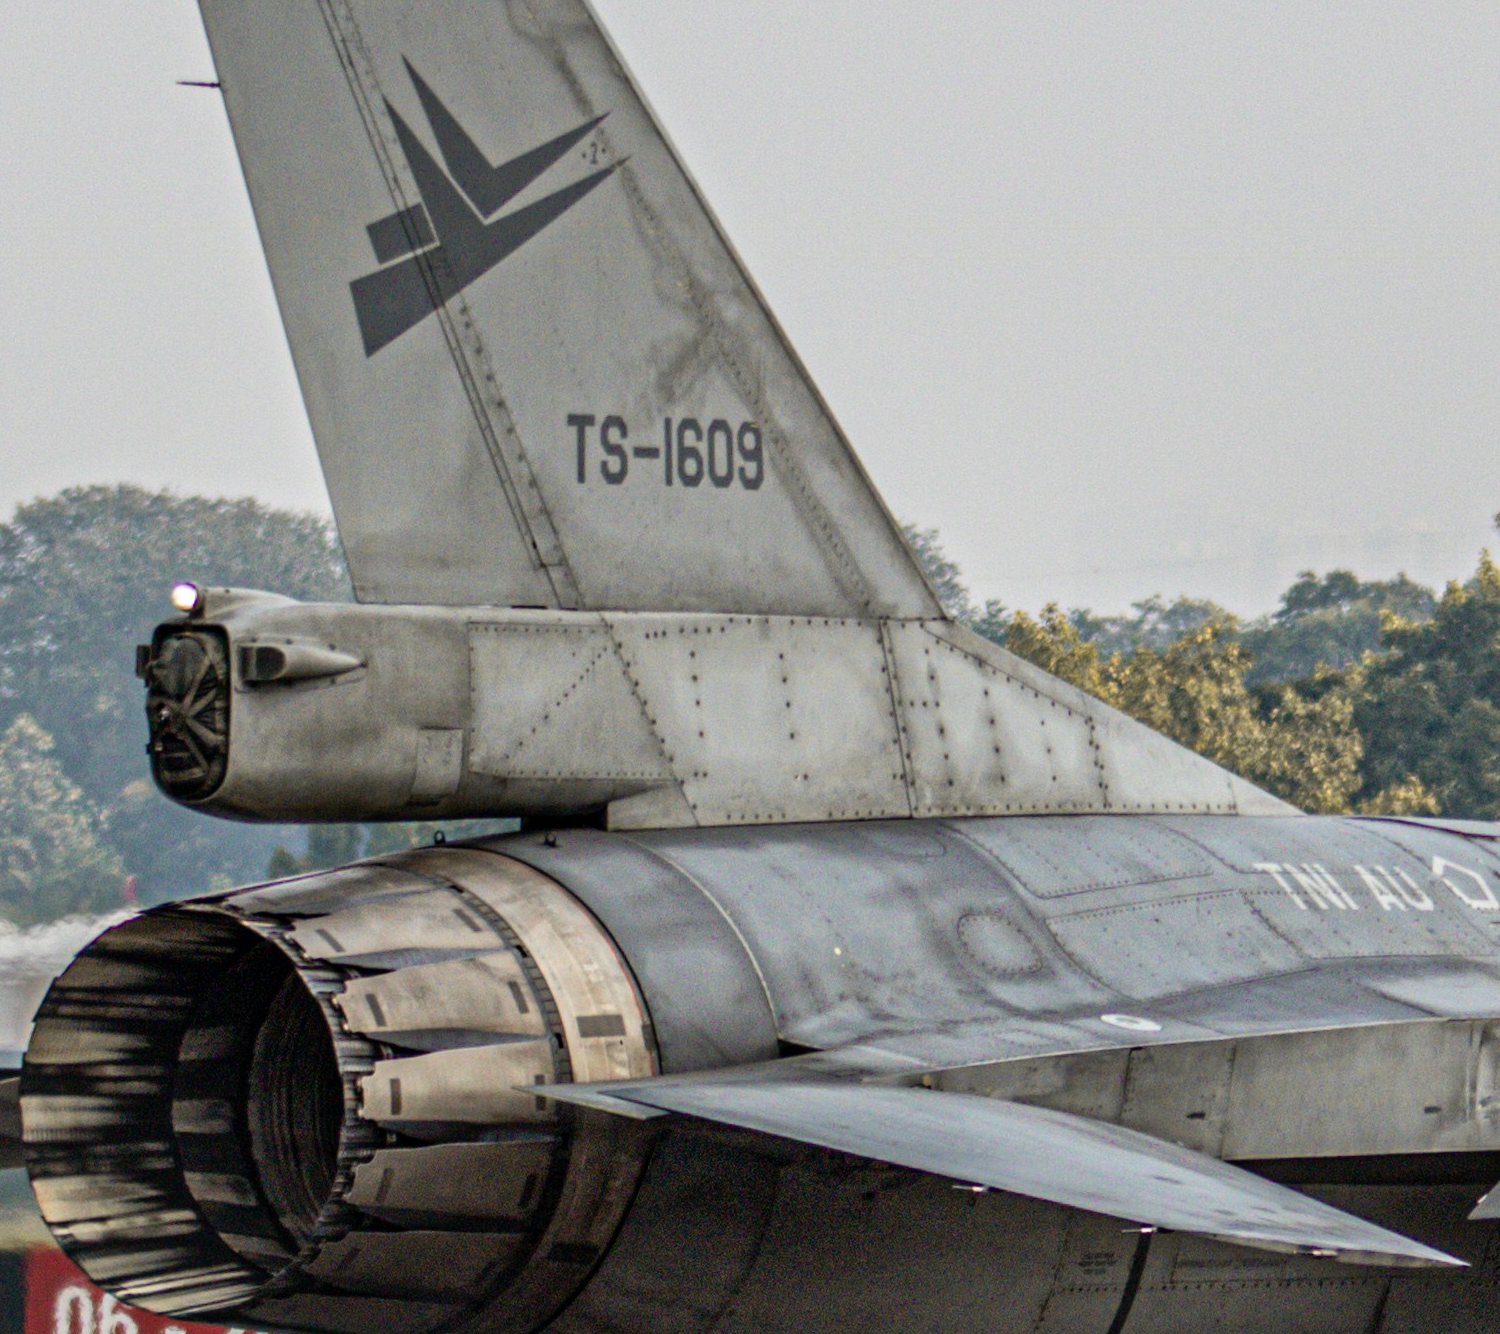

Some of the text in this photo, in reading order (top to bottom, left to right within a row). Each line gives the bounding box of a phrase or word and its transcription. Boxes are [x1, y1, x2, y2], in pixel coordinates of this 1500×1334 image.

[566, 413, 765, 490] TS-1609
[1253, 863, 1435, 911] TNI AU
